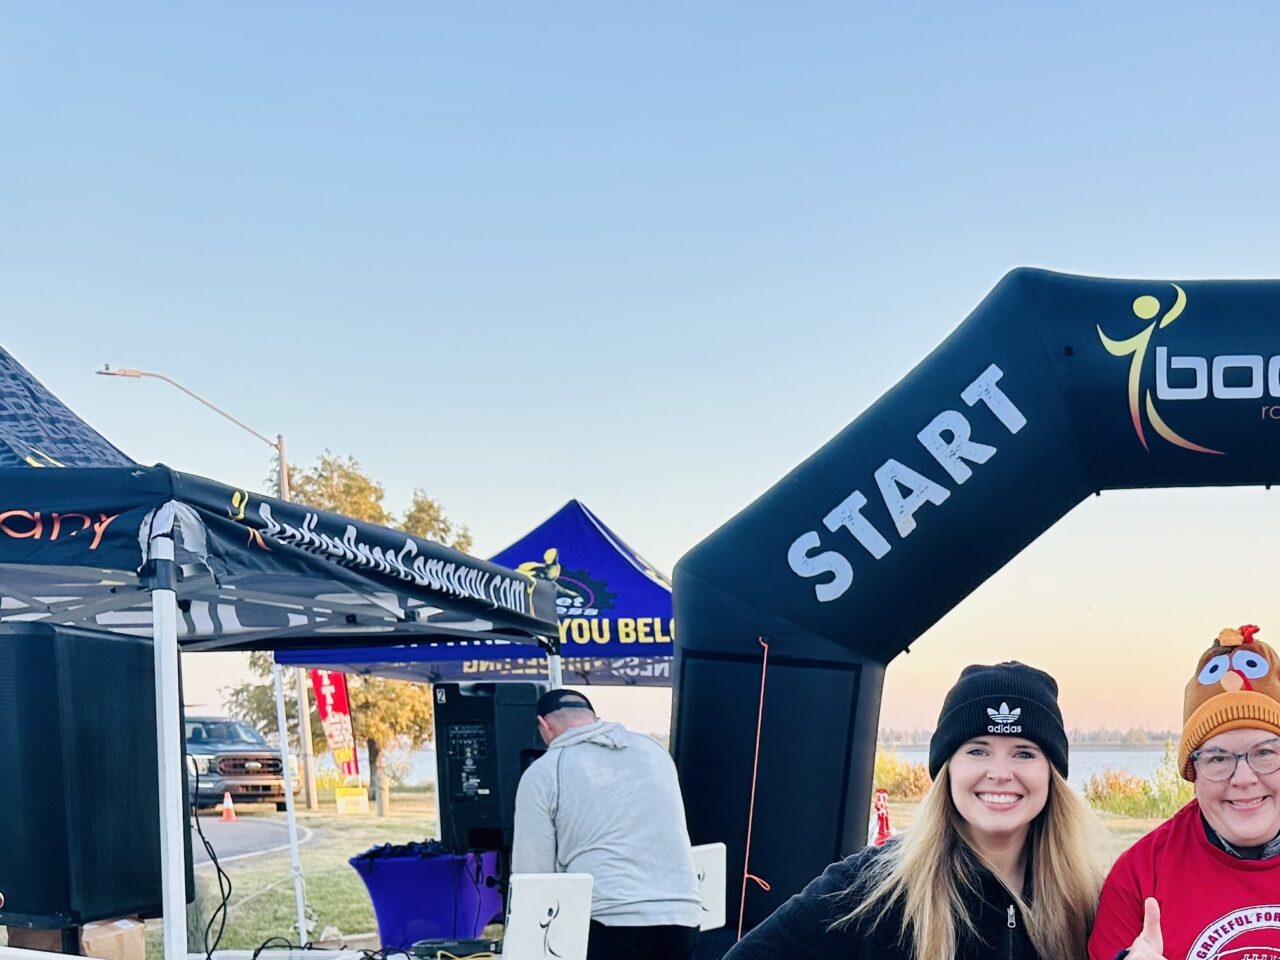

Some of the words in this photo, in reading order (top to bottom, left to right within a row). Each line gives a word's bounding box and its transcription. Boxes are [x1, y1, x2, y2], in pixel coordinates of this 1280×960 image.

[787, 363, 1027, 602] START
[557, 617, 611, 645] YOU
[617, 617, 676, 645] BEL
[987, 723, 1022, 734] adidas
[1196, 914, 1252, 959] GRATEFUL
